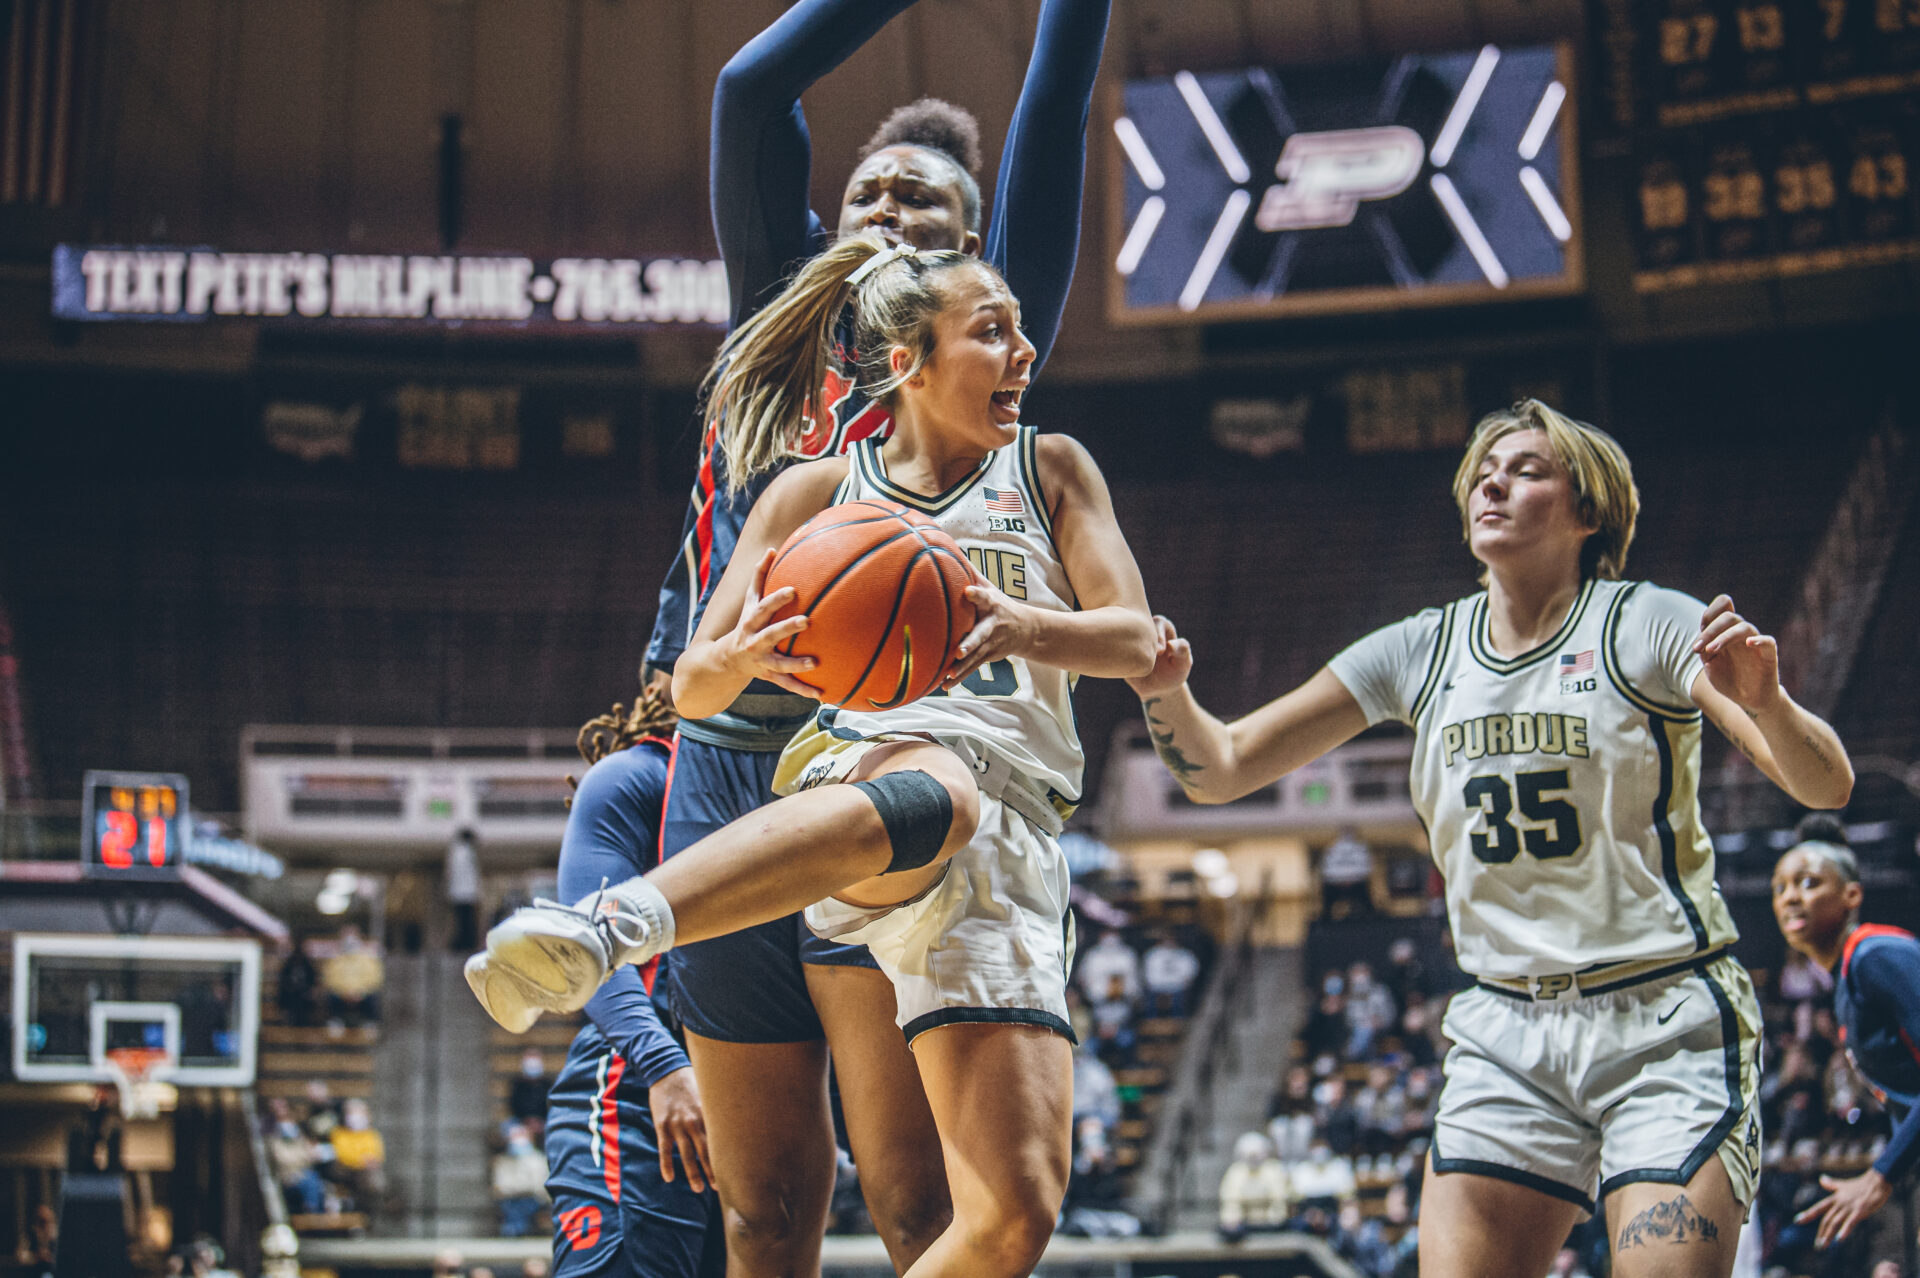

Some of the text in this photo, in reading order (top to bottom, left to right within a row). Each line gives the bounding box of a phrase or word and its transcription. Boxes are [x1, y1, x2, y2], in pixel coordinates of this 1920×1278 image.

[82, 251, 185, 314] TEXT
[186, 252, 328, 316] PETE'S
[331, 255, 534, 319] HELPLINE
[1442, 712, 1589, 767] PURDUE
[1463, 768, 1584, 864] 35
[1536, 973, 1572, 1000] P
